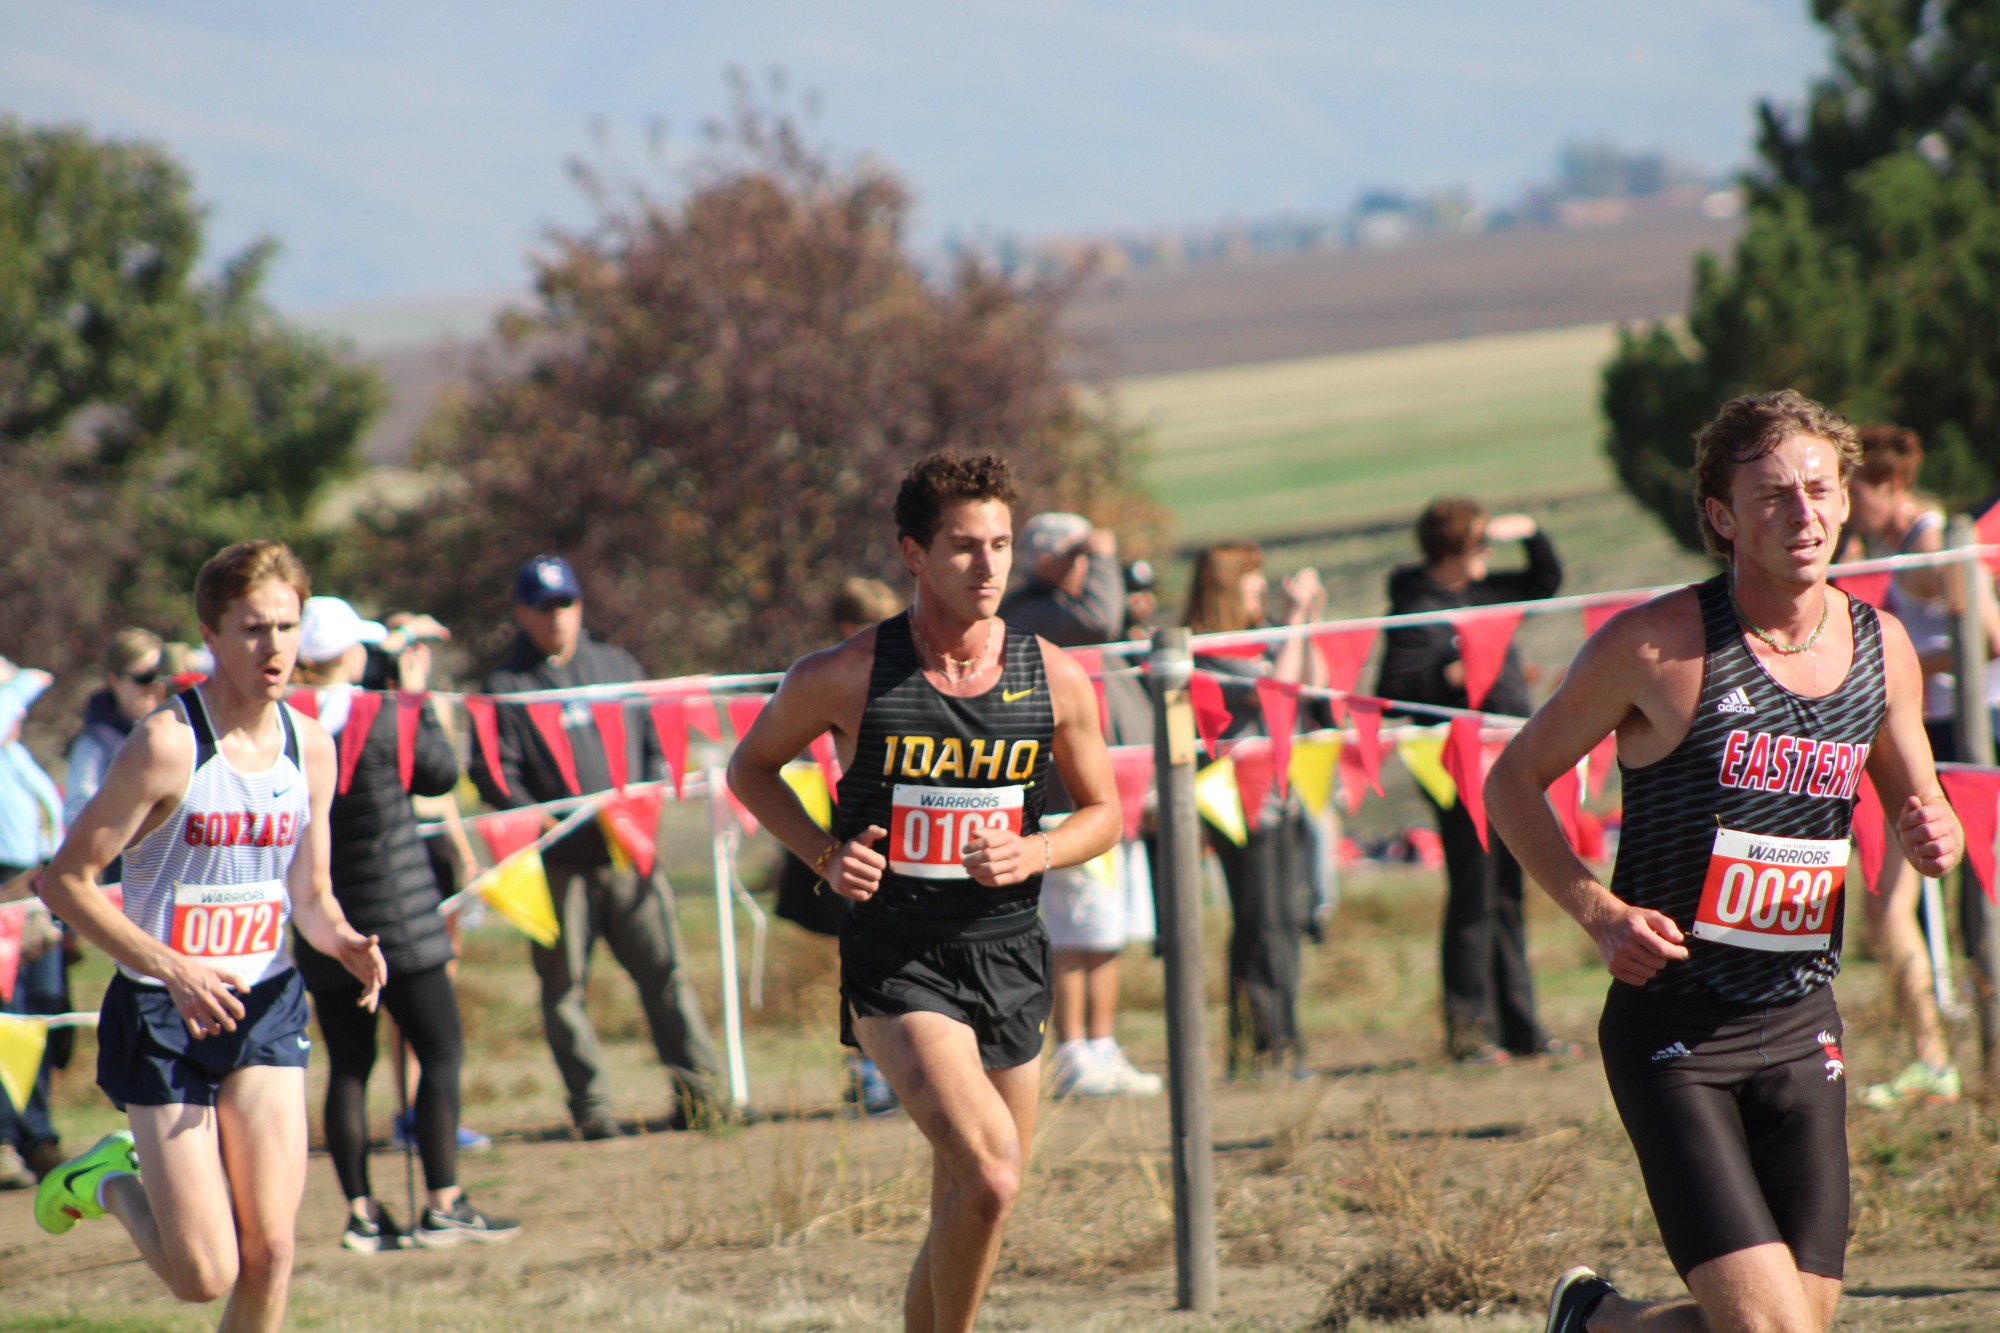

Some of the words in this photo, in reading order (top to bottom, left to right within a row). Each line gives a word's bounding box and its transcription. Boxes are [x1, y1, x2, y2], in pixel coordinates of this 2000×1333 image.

[1717, 702, 1755, 714] adidas
[883, 735, 1039, 780] IDAHO
[920, 794, 1000, 809] WARRIORS
[1747, 844, 1830, 864] WARRIORS
[201, 890, 265, 904] WARRIORS
[1716, 862, 1833, 931] 0039
[182, 903, 273, 955] 0072
